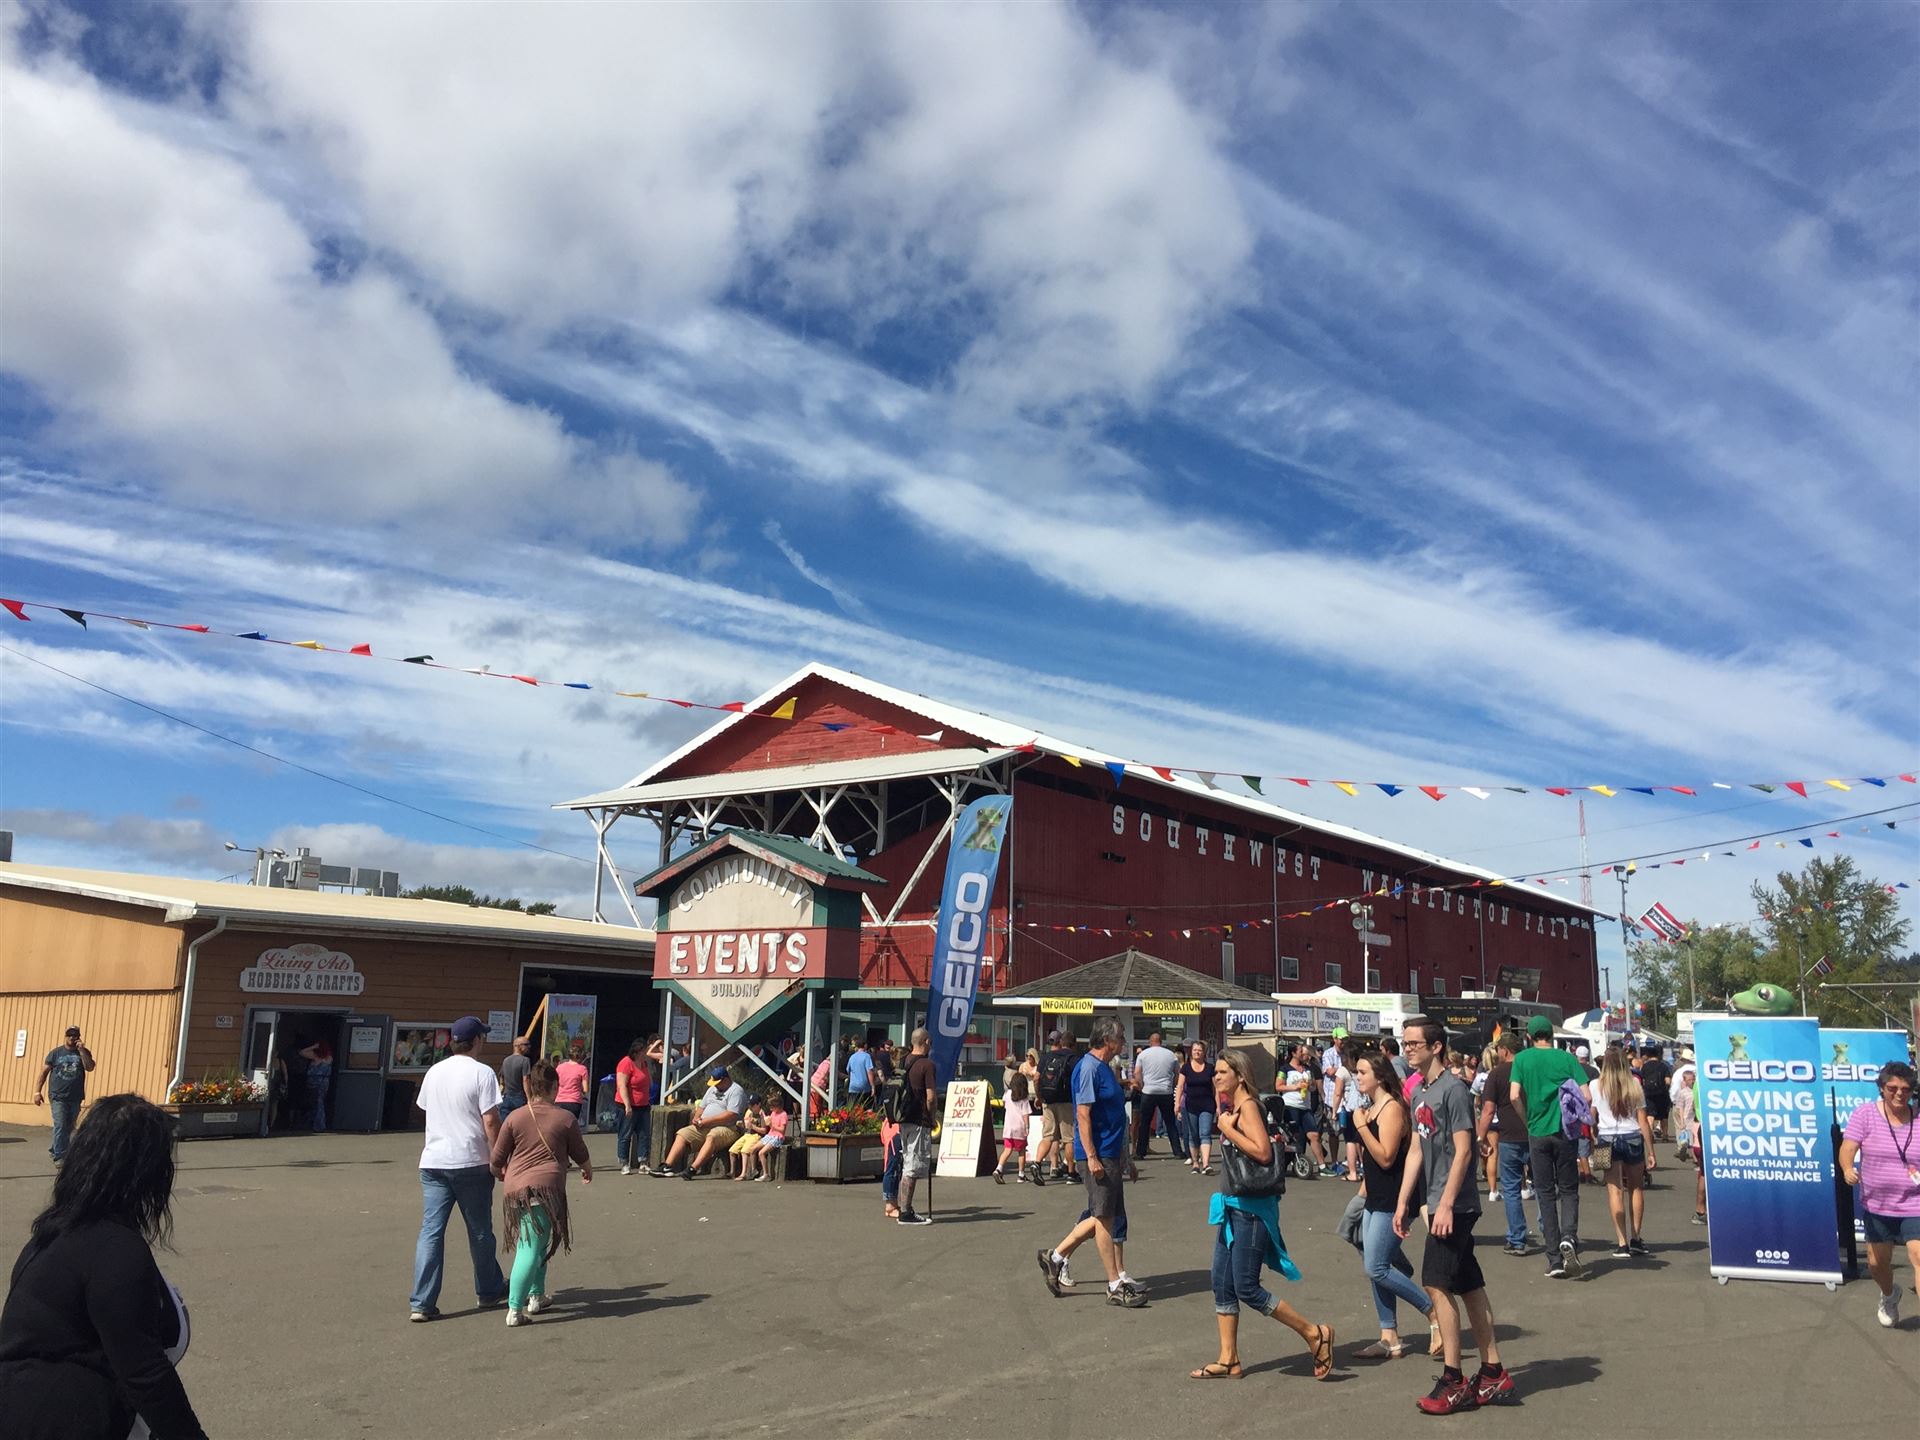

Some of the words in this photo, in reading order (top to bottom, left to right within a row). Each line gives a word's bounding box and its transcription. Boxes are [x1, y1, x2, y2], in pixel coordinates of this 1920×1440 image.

[1112, 804, 1321, 881] SOUTHWEST
[1361, 868, 1511, 926] WASHINGTON
[677, 857, 810, 913] COMMUNITY
[263, 950, 314, 973] Living
[317, 955, 350, 971] Arts
[669, 932, 808, 974] EVENTS
[938, 871, 989, 1038] GEICO
[247, 971, 301, 990] HOBBIES
[303, 974, 313, 990] &
[315, 974, 360, 992] CRAFTS
[710, 983, 760, 998] BUILDING
[1042, 1000, 1093, 1011] INFORMATION
[1144, 1001, 1201, 1012] INFORMATION
[1354, 1022, 1376, 1033] JEWELRY
[1703, 1059, 1816, 1083] GEICO
[1821, 1063, 1885, 1082] GEIC
[953, 1084, 980, 1096] LIVING
[1707, 1089, 1815, 1112] SAVING
[954, 1096, 975, 1108] ARTS
[1708, 1112, 1818, 1134] PEOPLE
[1710, 1134, 1818, 1158] MONEY
[1711, 1157, 1727, 1166] ON
[1729, 1158, 1760, 1167] MORE
[1762, 1159, 1792, 1169] THAN
[1794, 1160, 1820, 1170] JUST
[1712, 1168, 1741, 1179] CAR
[1743, 1169, 1822, 1182] INSURANCE
